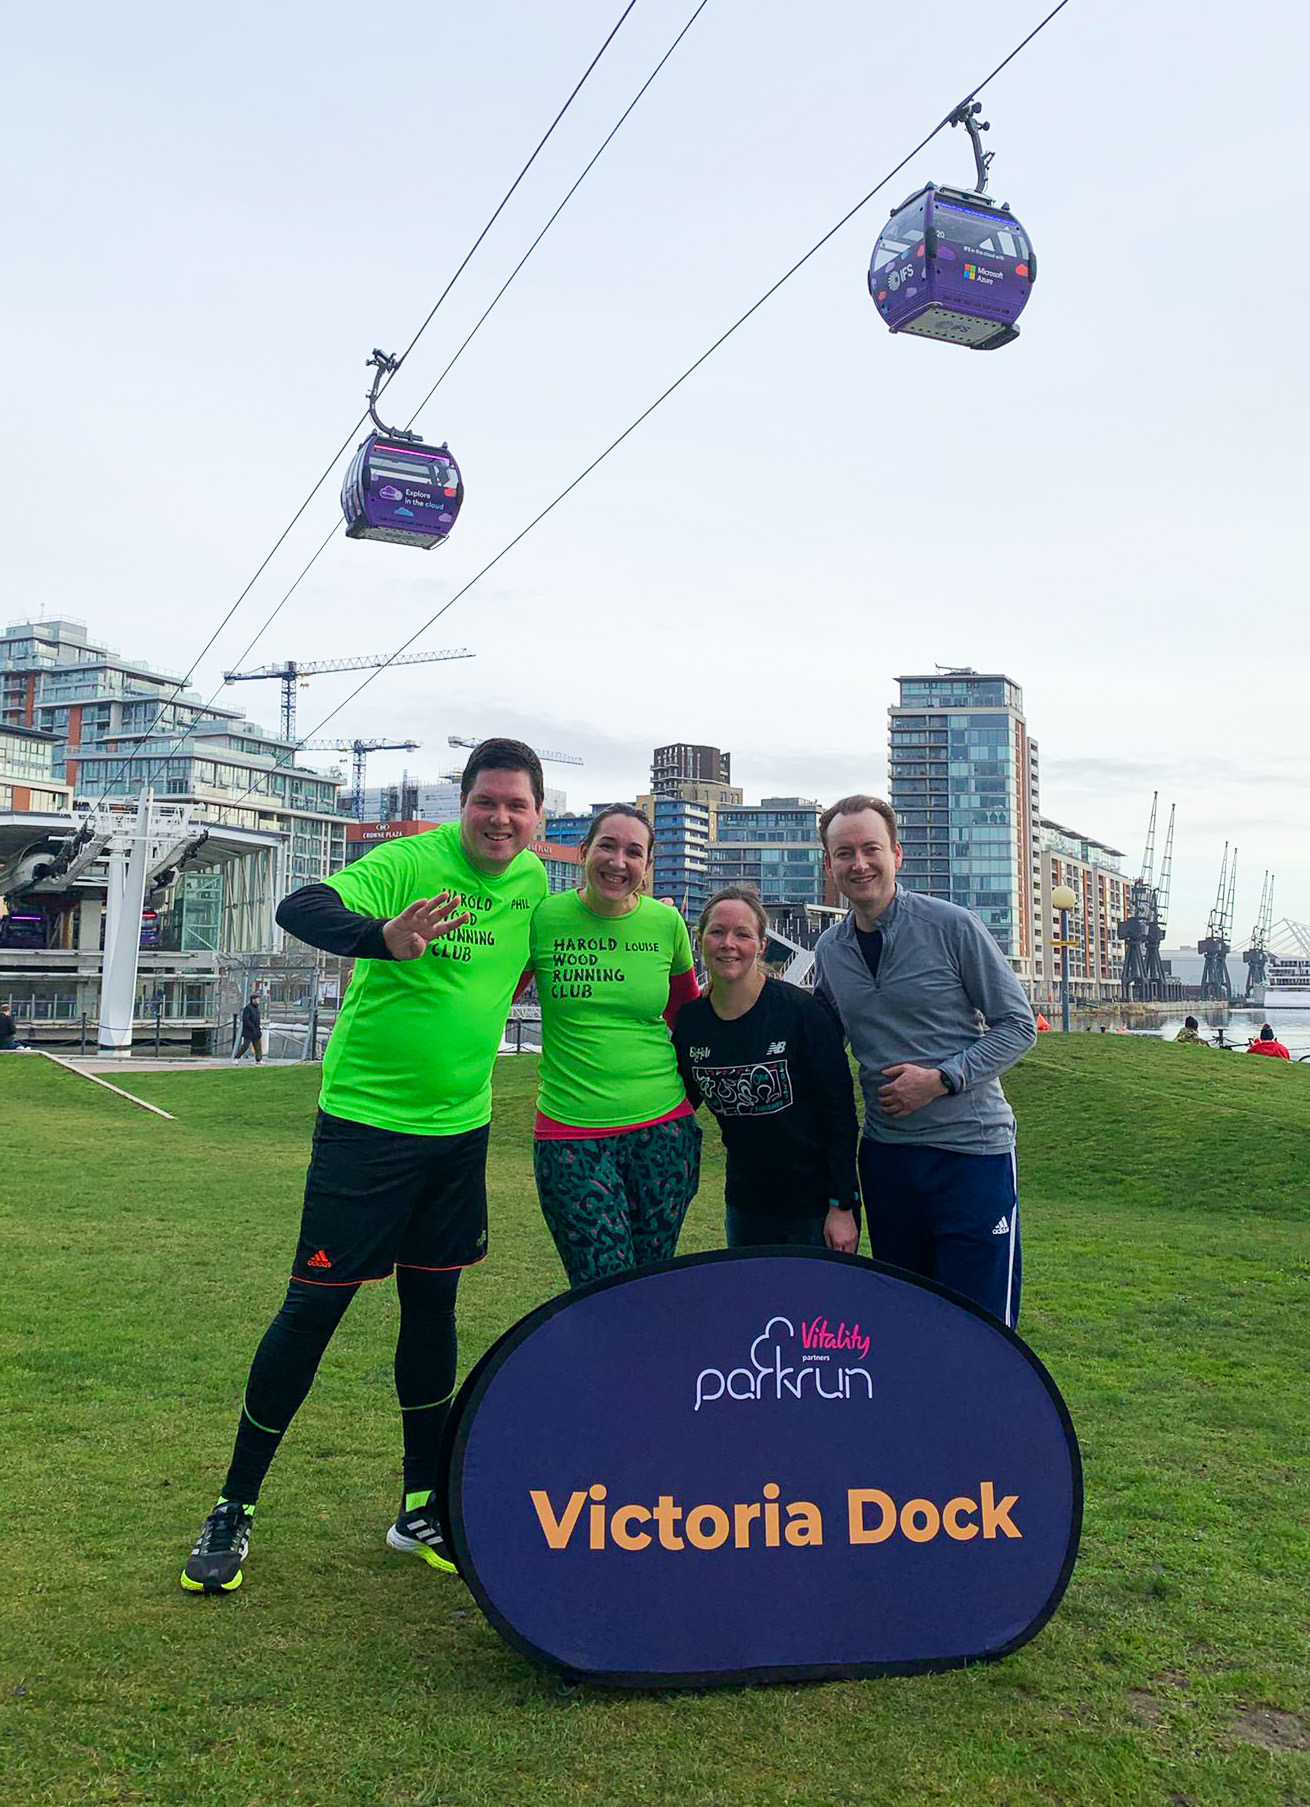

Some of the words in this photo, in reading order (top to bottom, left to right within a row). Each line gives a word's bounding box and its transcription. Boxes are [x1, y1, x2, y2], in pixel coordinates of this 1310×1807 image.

[936, 230, 945, 239] 20
[900, 263, 914, 283] IFS
[978, 266, 1004, 280] Microsoft
[976, 275, 994, 285] Azure
[405, 488, 431, 499] Explore
[404, 497, 411, 505] in
[412, 499, 424, 507] the
[425, 501, 444, 510] cloud
[362, 831, 384, 839] CROWNE
[385, 830, 403, 838] PLAZA
[511, 898, 530, 910] PHIL
[554, 938, 618, 951] HAROLD
[626, 942, 659, 951] LOUISE
[431, 943, 471, 961] CLUB
[553, 954, 598, 966] WOOD
[552, 969, 625, 982] RUNNING
[552, 984, 592, 999] CLUB
[307, 1260, 332, 1268] adidas
[800, 1316, 871, 1360] Vitality
[802, 1353, 831, 1362] partners
[694, 1345, 873, 1411] parkrun
[529, 1482, 824, 1551] Victoria
[846, 1480, 1024, 1546] Dock
